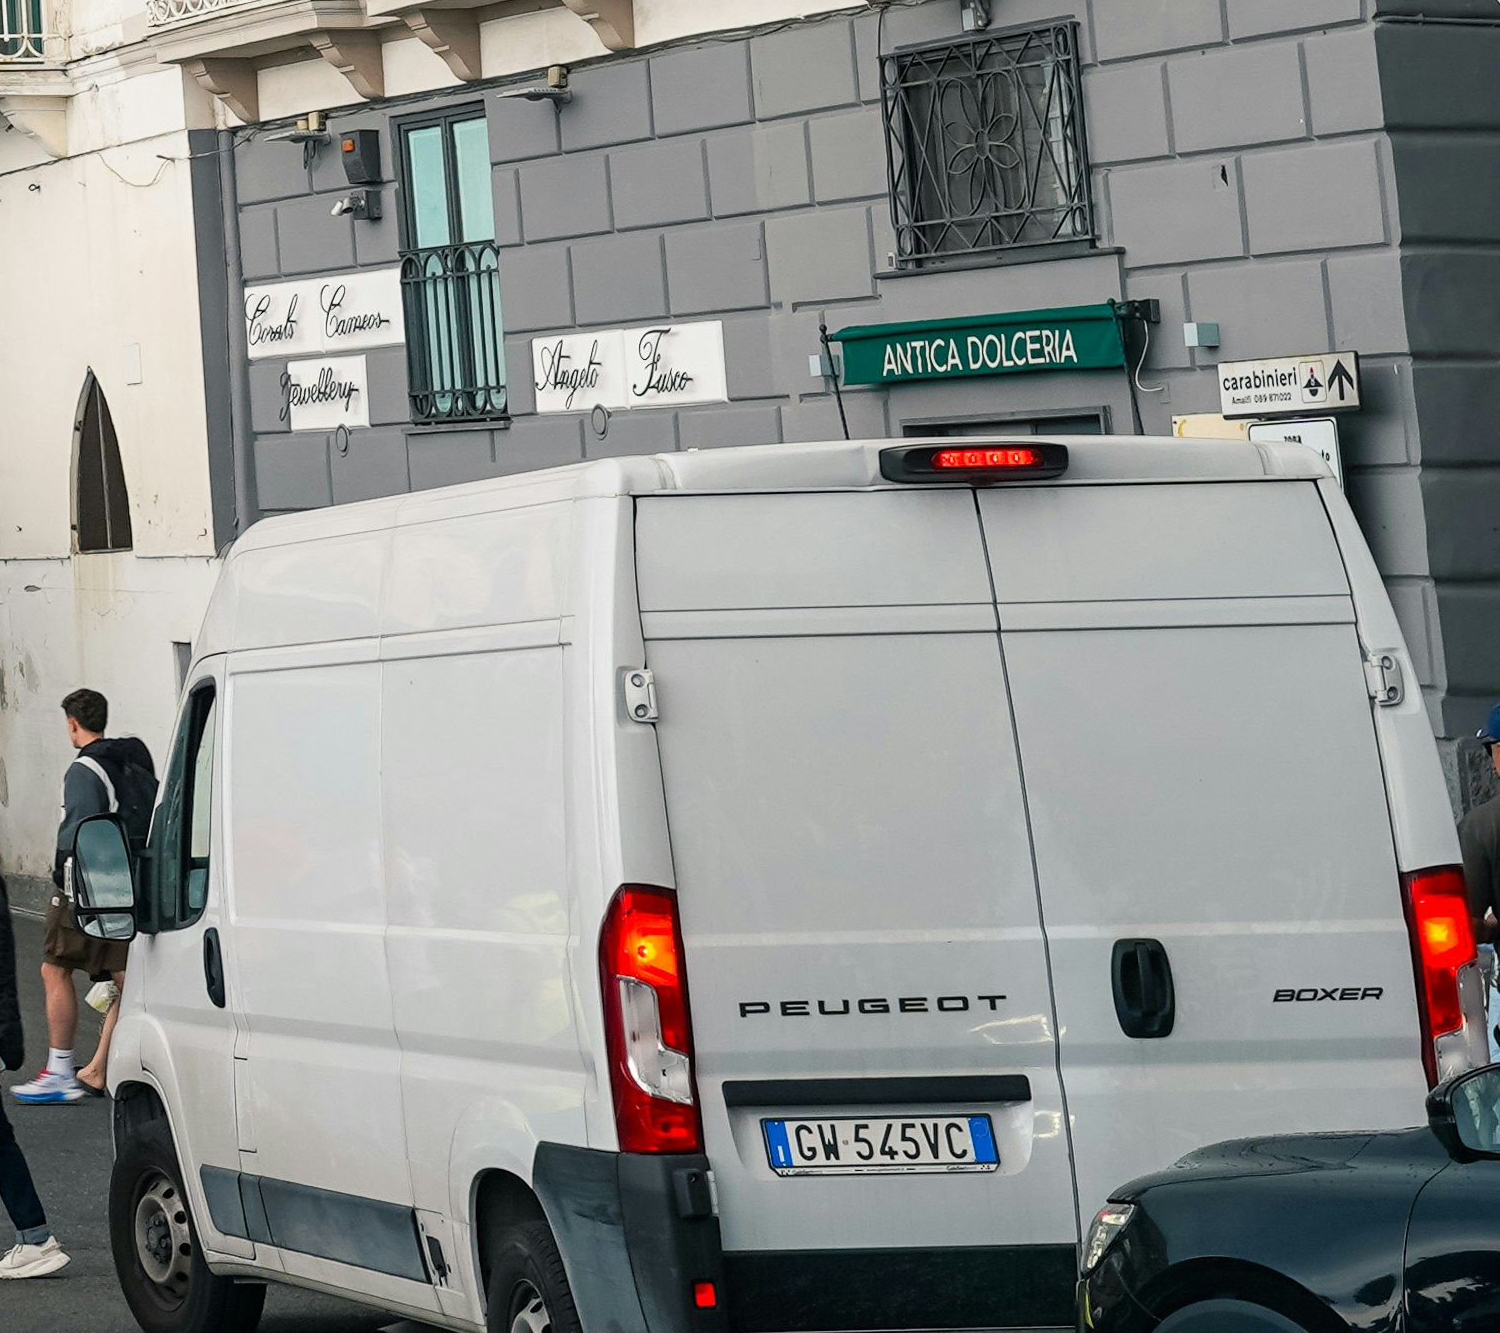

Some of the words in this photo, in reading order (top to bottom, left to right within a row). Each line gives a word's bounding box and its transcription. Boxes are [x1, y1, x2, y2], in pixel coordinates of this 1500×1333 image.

[320, 284, 390, 339] Cameos
[535, 339, 603, 410] Angelo
[632, 327, 693, 397] Fusco
[881, 339, 964, 377] ANTICA
[966, 329, 1078, 371] DOLCERIA
[1222, 367, 1298, 392] carabinieri
[738, 994, 1008, 1019] PEUGEOT
[1272, 986, 1384, 1003] BOXER
